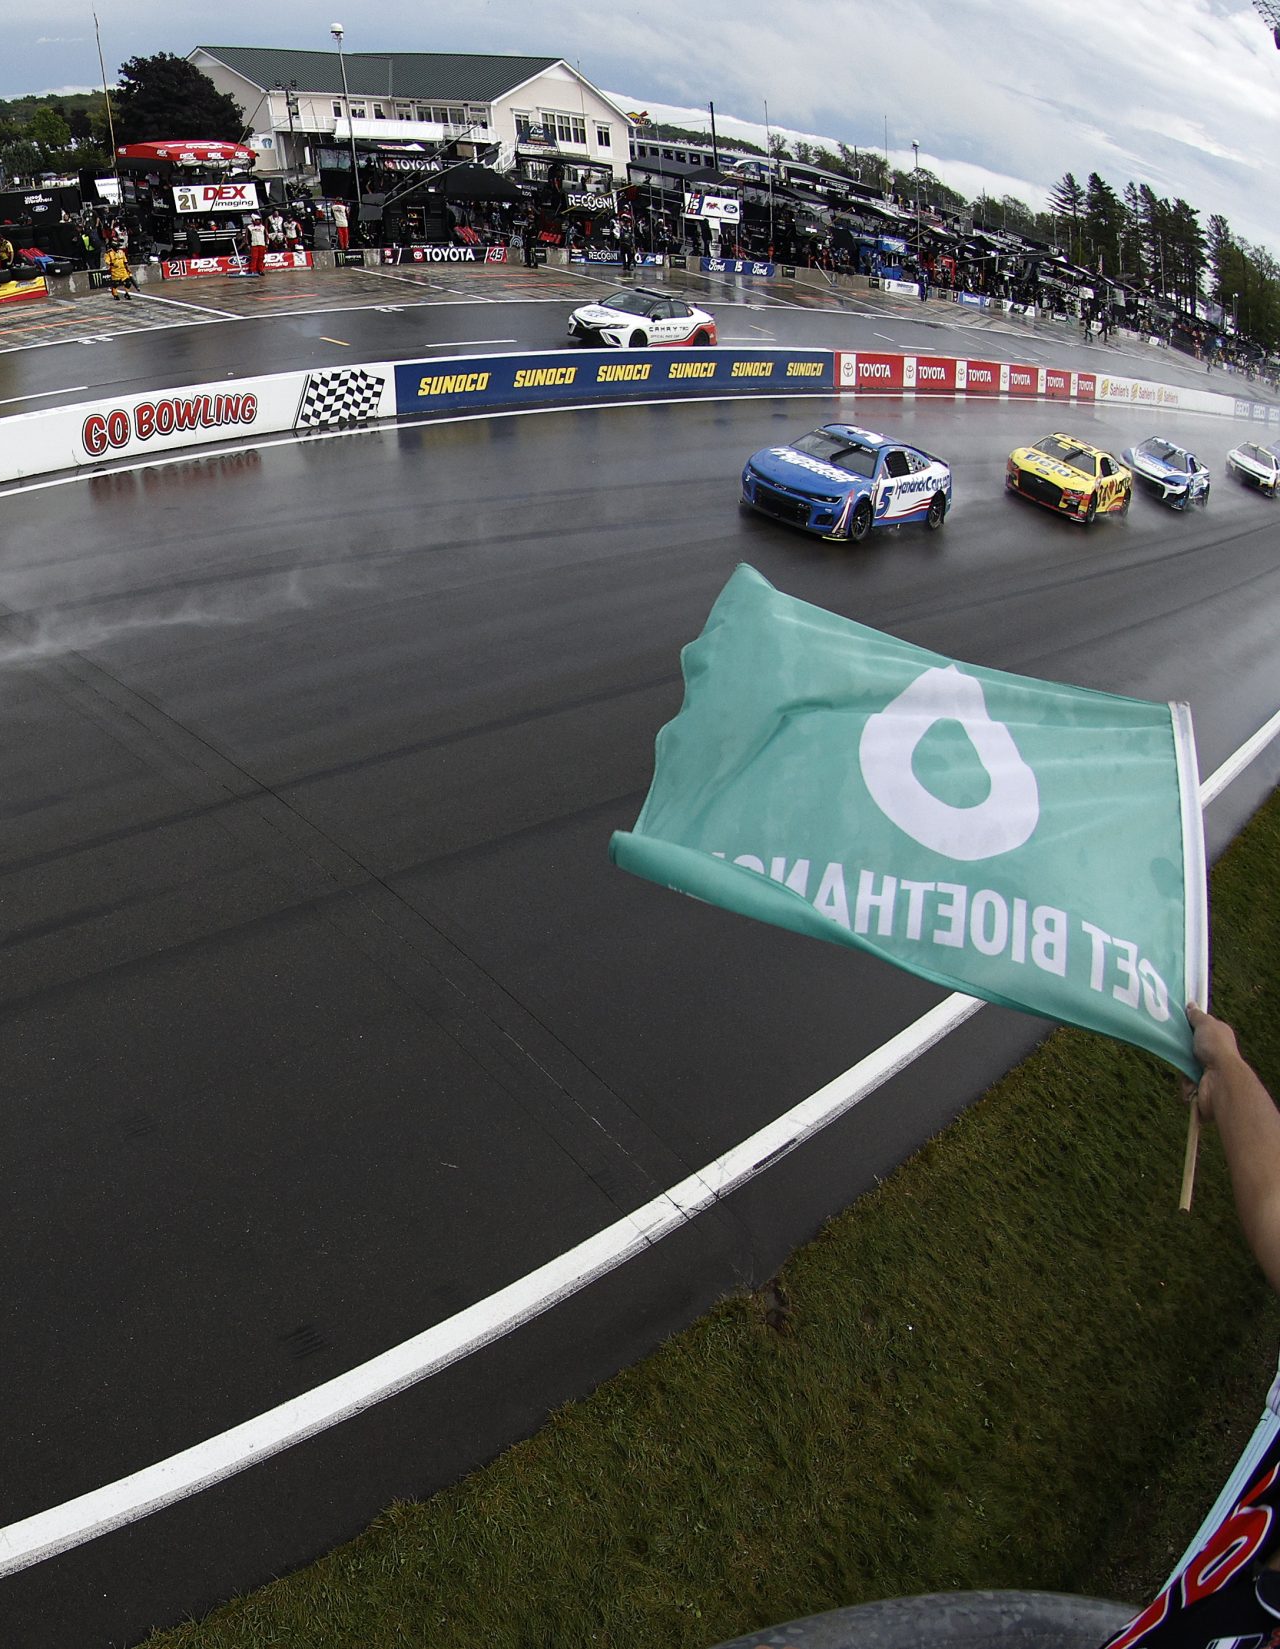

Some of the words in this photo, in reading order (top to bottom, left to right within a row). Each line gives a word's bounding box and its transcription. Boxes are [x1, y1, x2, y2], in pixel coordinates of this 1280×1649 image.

[394, 159, 440, 171] TOYOTA
[203, 186, 246, 201] DEX
[178, 194, 197, 211] 21
[423, 249, 475, 262] TOYOTA
[489, 248, 504, 262] 45
[169, 260, 187, 277] 21
[190, 257, 219, 269] DEX
[708, 258, 726, 271] Ford
[734, 261, 742, 272] 15
[752, 261, 768, 275] Ford
[514, 366, 576, 388] SUNOCO
[597, 364, 651, 382] SUNOCO
[669, 362, 717, 378] SUNOCO
[731, 362, 774, 377] SUNOCO
[786, 362, 824, 377] SUNOCO
[859, 363, 891, 378] TOYOTA
[918, 365, 946, 380] TOYOTA
[968, 369, 992, 383] TOYOTA
[418, 373, 490, 396] SUNOCO
[1011, 373, 1031, 386] TOYOTA
[1047, 376, 1065, 389] TOYOTA
[1078, 379, 1094, 392] TOYOTA
[1110, 384, 1129, 398] Sahlen's
[1138, 388, 1156, 401] Sahlen's
[82, 409, 131, 457] GO
[134, 392, 258, 441] BOWLING
[875, 486, 895, 518] 5
